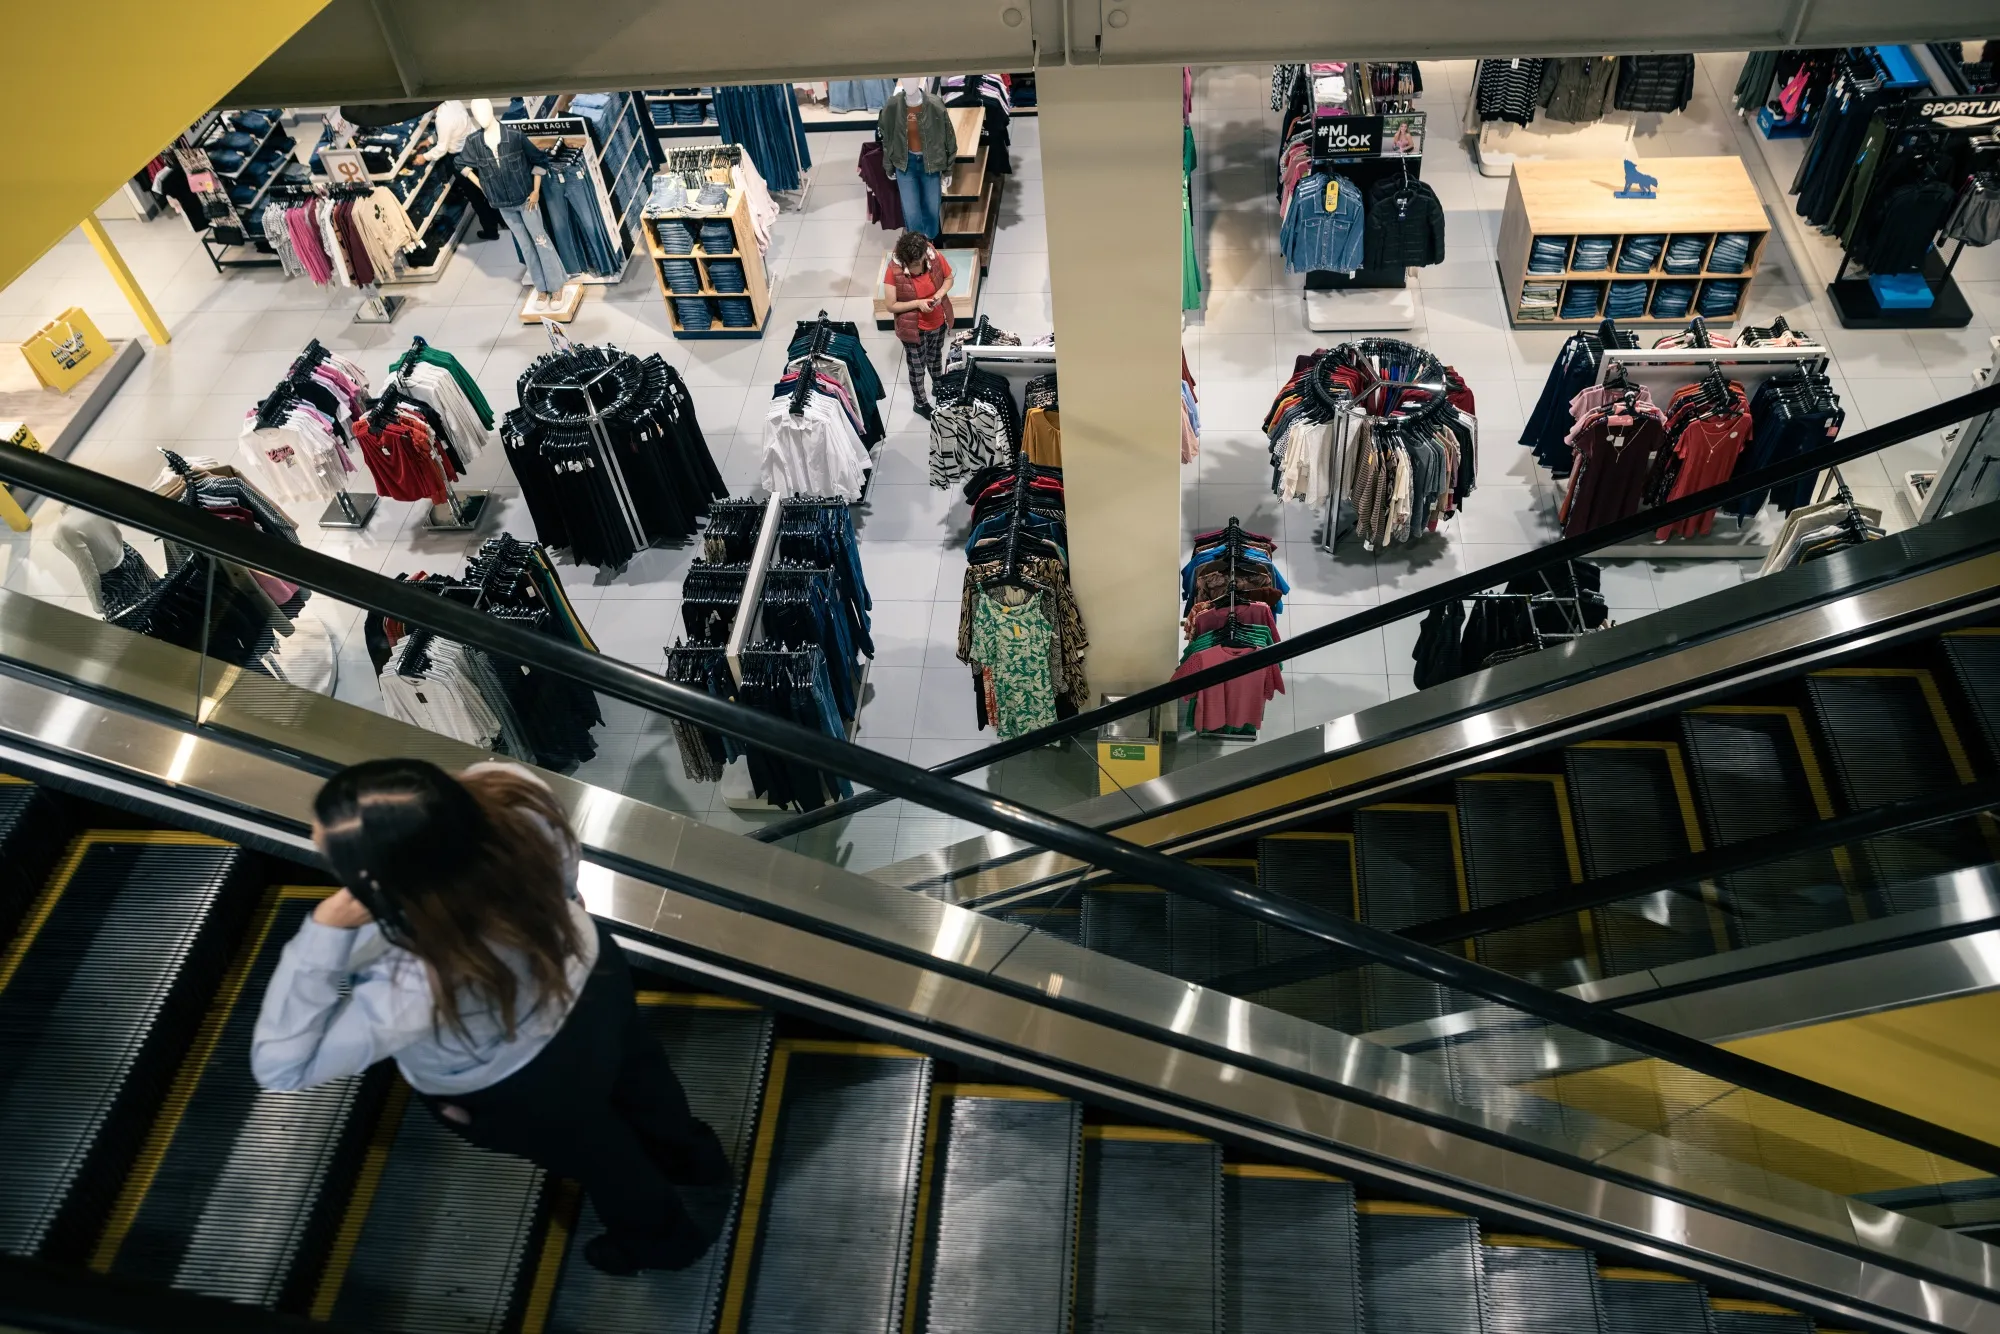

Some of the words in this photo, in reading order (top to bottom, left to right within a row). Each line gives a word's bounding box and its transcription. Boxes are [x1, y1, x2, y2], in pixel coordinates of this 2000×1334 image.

[544, 122, 571, 130] EAGLE
[1317, 124, 1348, 137] #MI
[1328, 134, 1371, 147] LOOK
